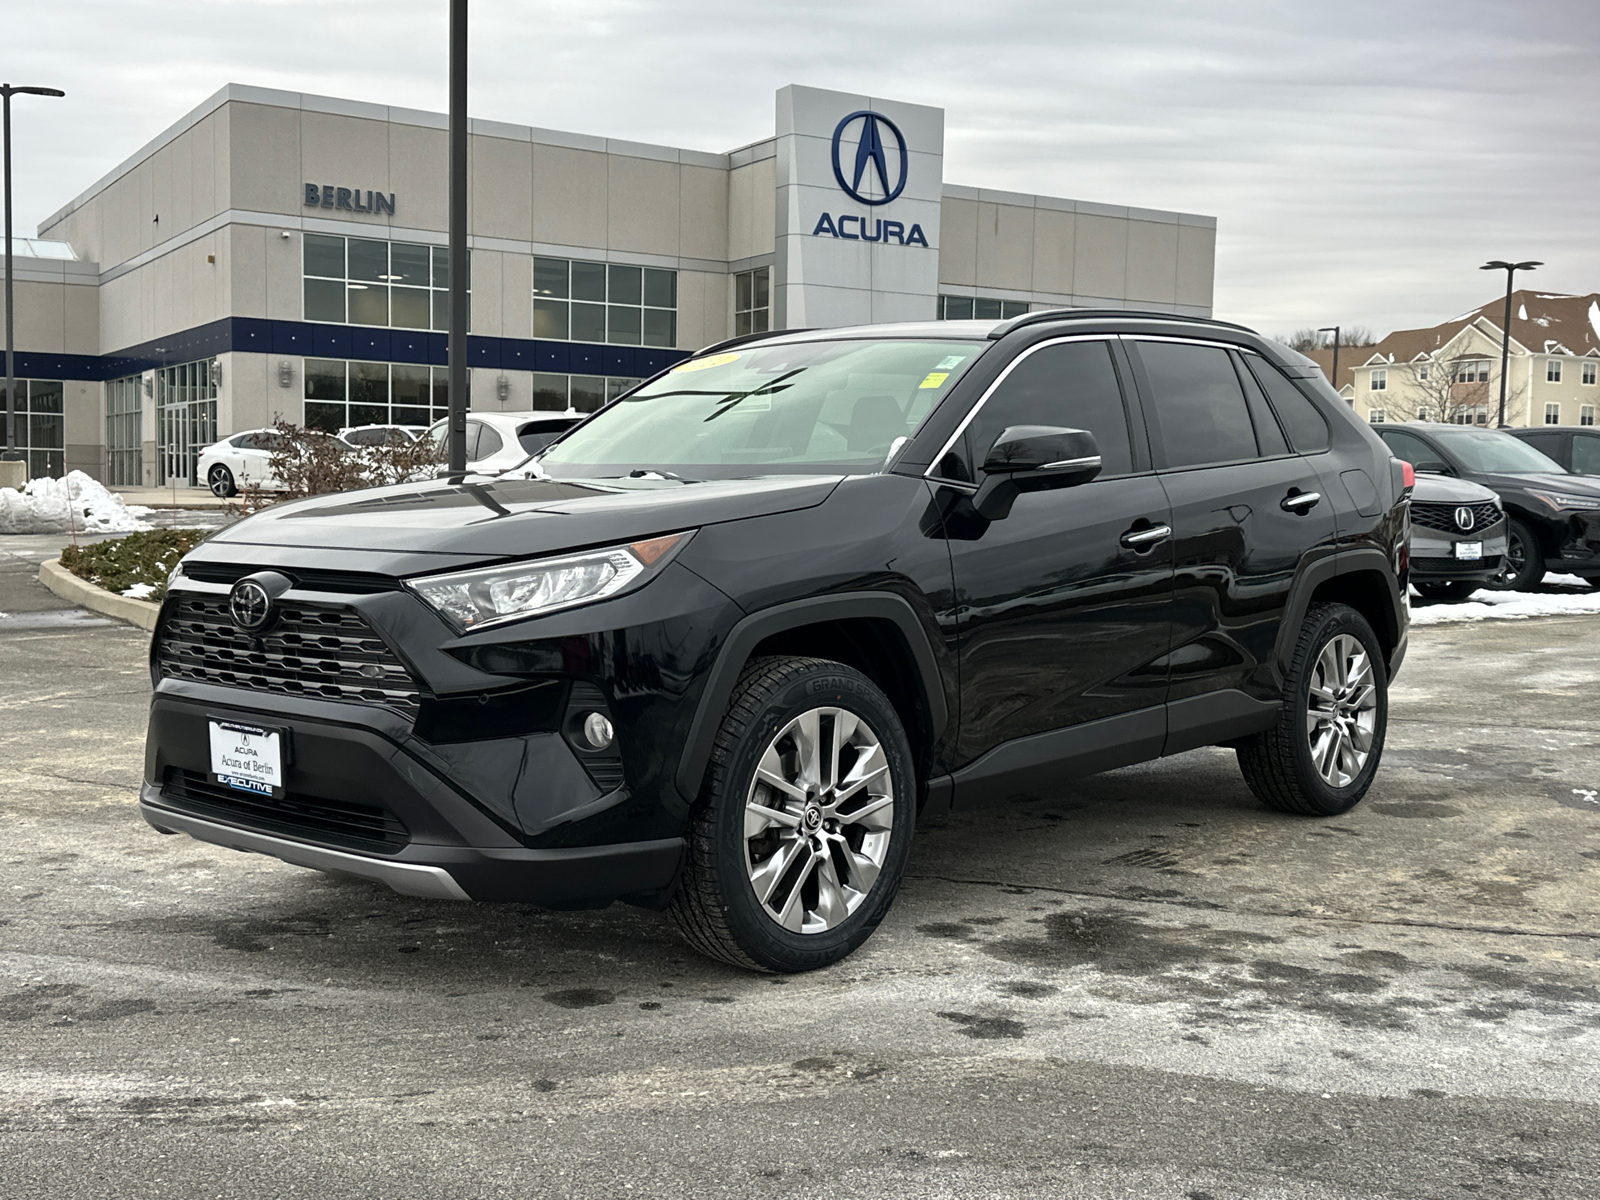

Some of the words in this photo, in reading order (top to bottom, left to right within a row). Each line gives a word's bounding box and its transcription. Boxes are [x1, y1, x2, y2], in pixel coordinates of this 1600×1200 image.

[303, 183, 395, 215] BERLIN
[813, 212, 929, 247] ACURA
[812, 678, 854, 691] GRAND
[234, 746, 258, 757] ACURA
[221, 755, 242, 769] Acura
[243, 760, 251, 770] of
[253, 760, 274, 775] Berlin
[217, 774, 273, 794] EXECUTIVE
